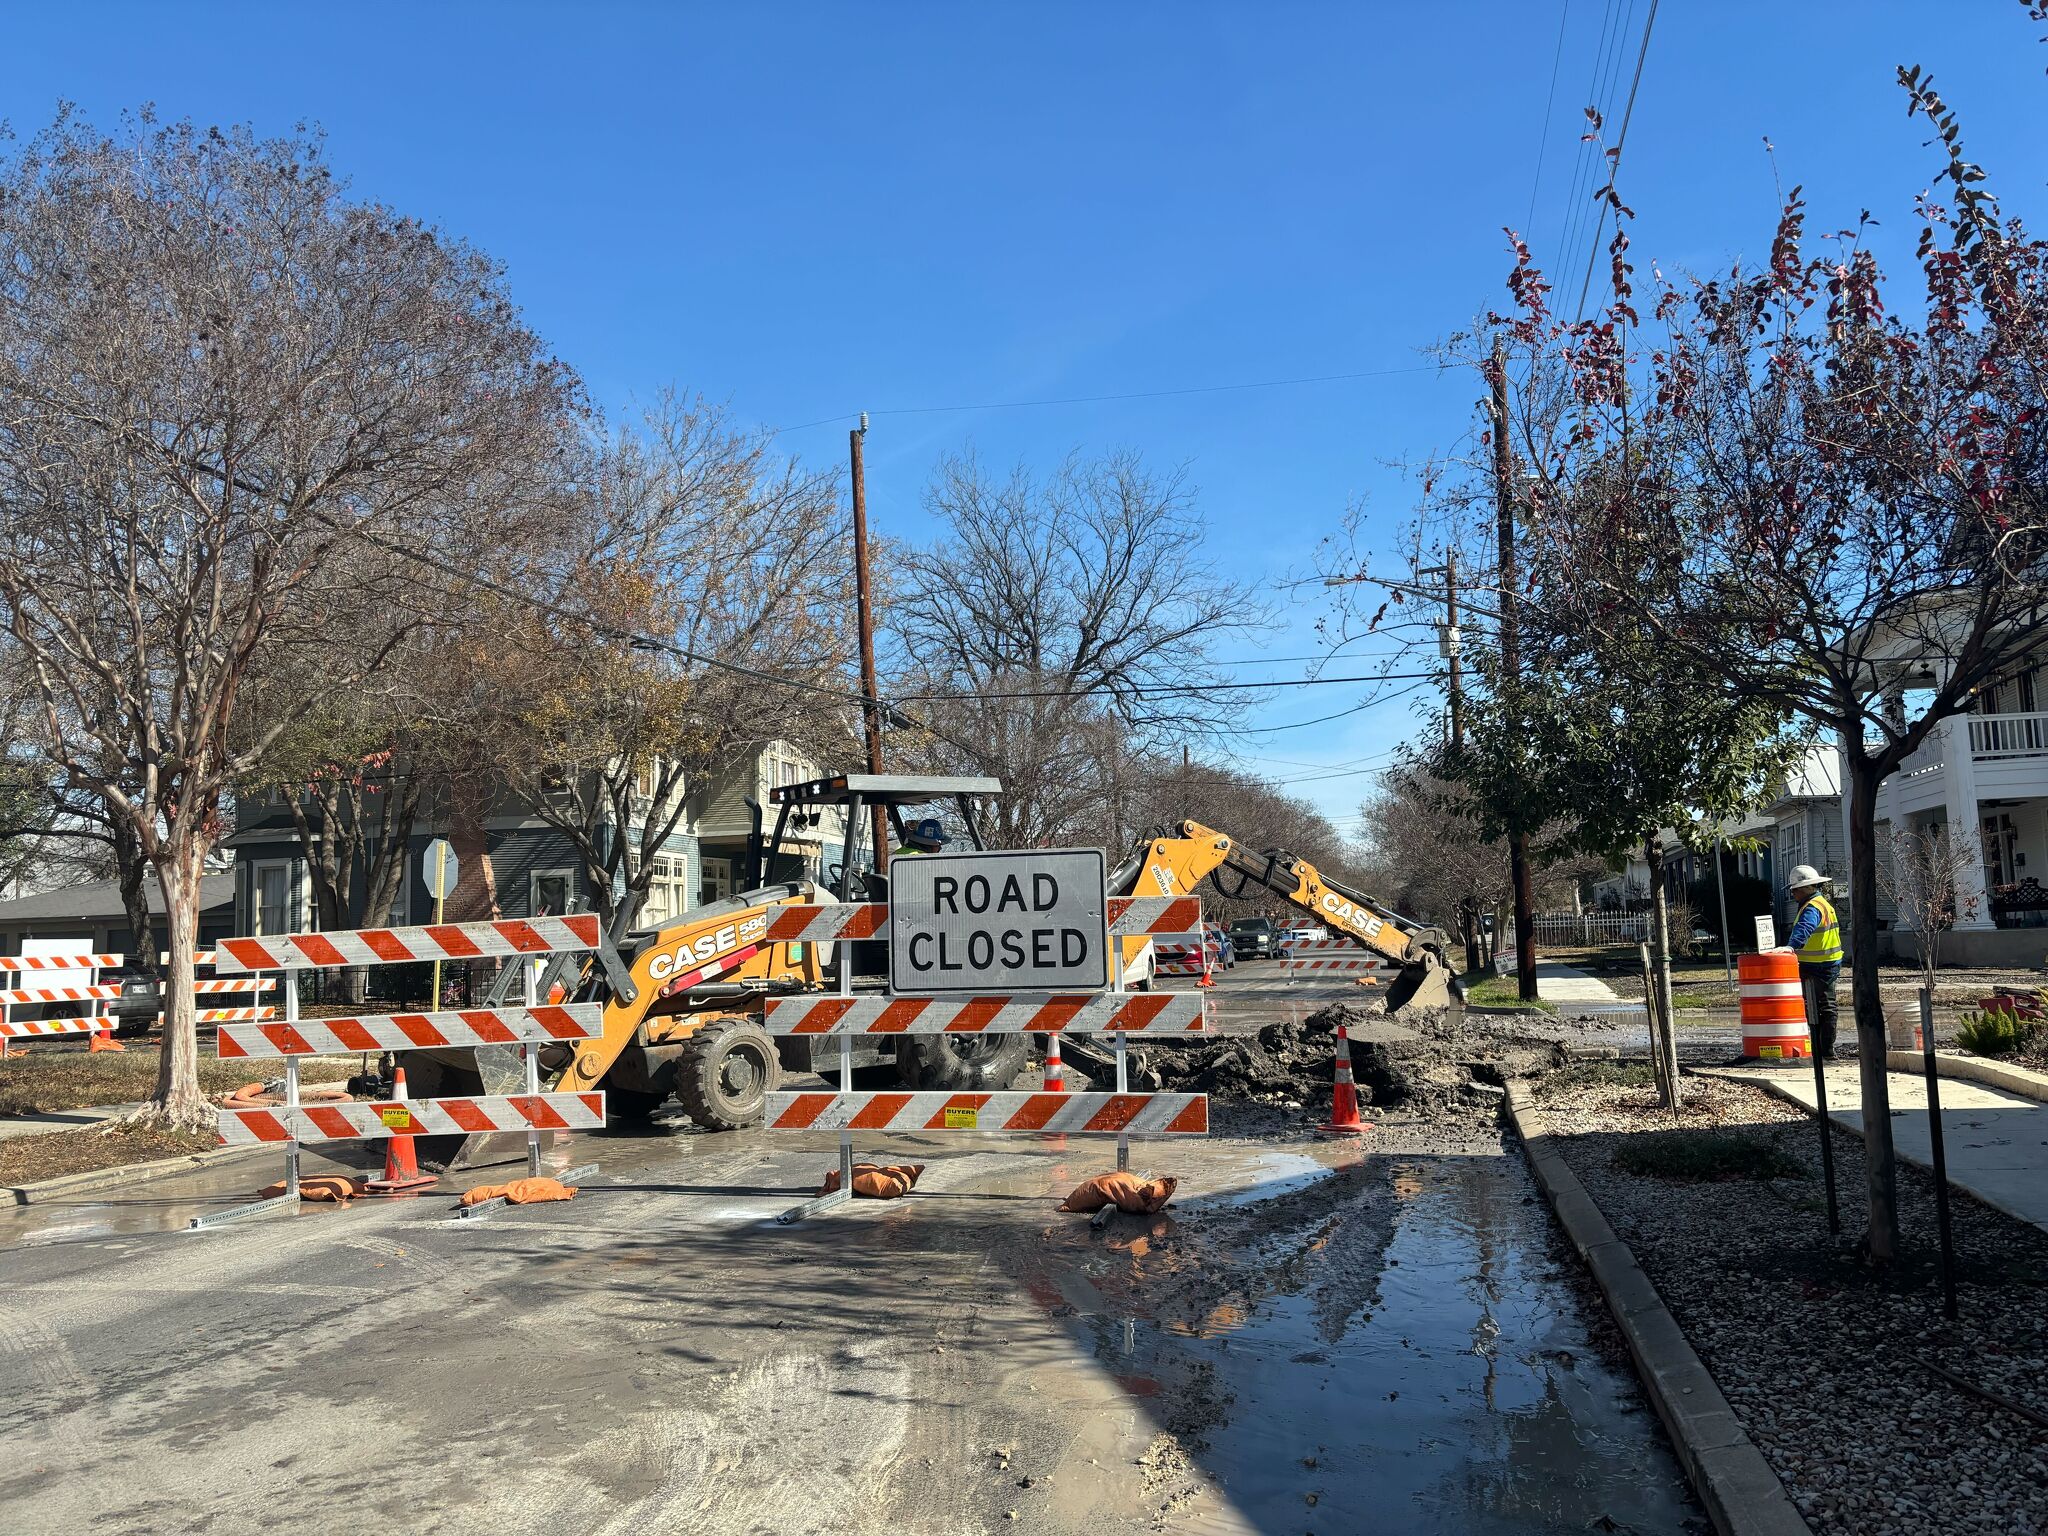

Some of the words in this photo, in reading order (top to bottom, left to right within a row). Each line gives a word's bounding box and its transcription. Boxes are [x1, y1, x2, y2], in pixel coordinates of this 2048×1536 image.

[934, 873, 1059, 914] ROAD
[1322, 892, 1384, 938] CASE
[649, 923, 737, 980] CASE
[909, 928, 1088, 971] CLOSED
